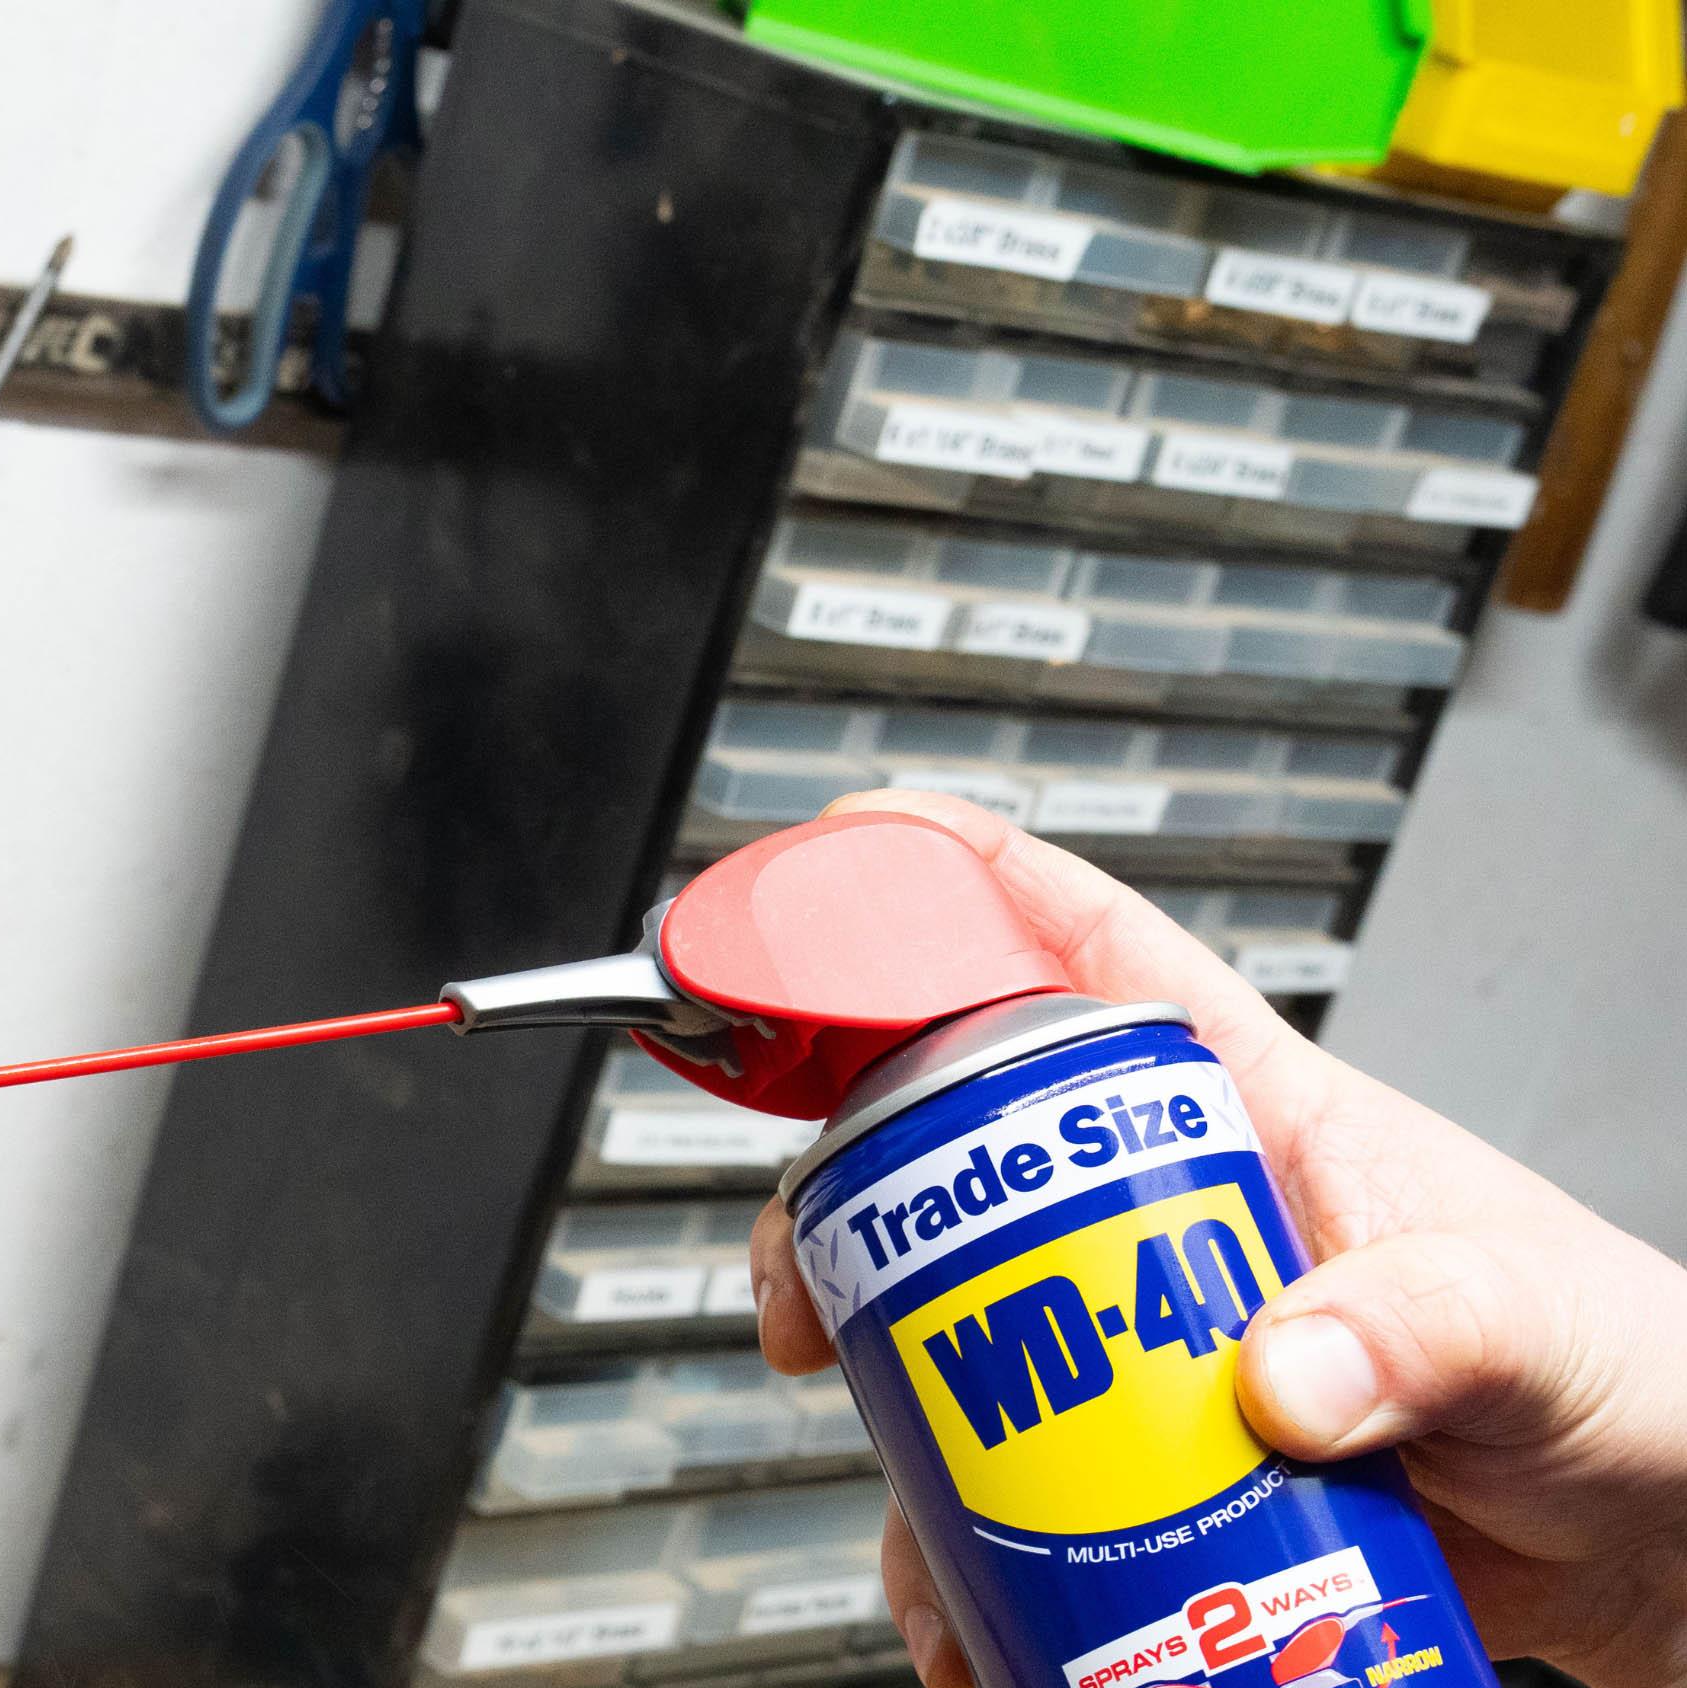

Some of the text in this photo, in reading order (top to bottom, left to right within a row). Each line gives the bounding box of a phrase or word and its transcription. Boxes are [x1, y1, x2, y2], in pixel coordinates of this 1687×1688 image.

[847, 1094, 1208, 1271] Trade Size
[922, 1219, 1266, 1451] WD-40
[1067, 1461, 1293, 1564] MULTI-USE PRODUCT
[1187, 1587, 1267, 1670] 2
[1261, 1572, 1353, 1617] WAYS
[1365, 1646, 1443, 1688] NARROW
